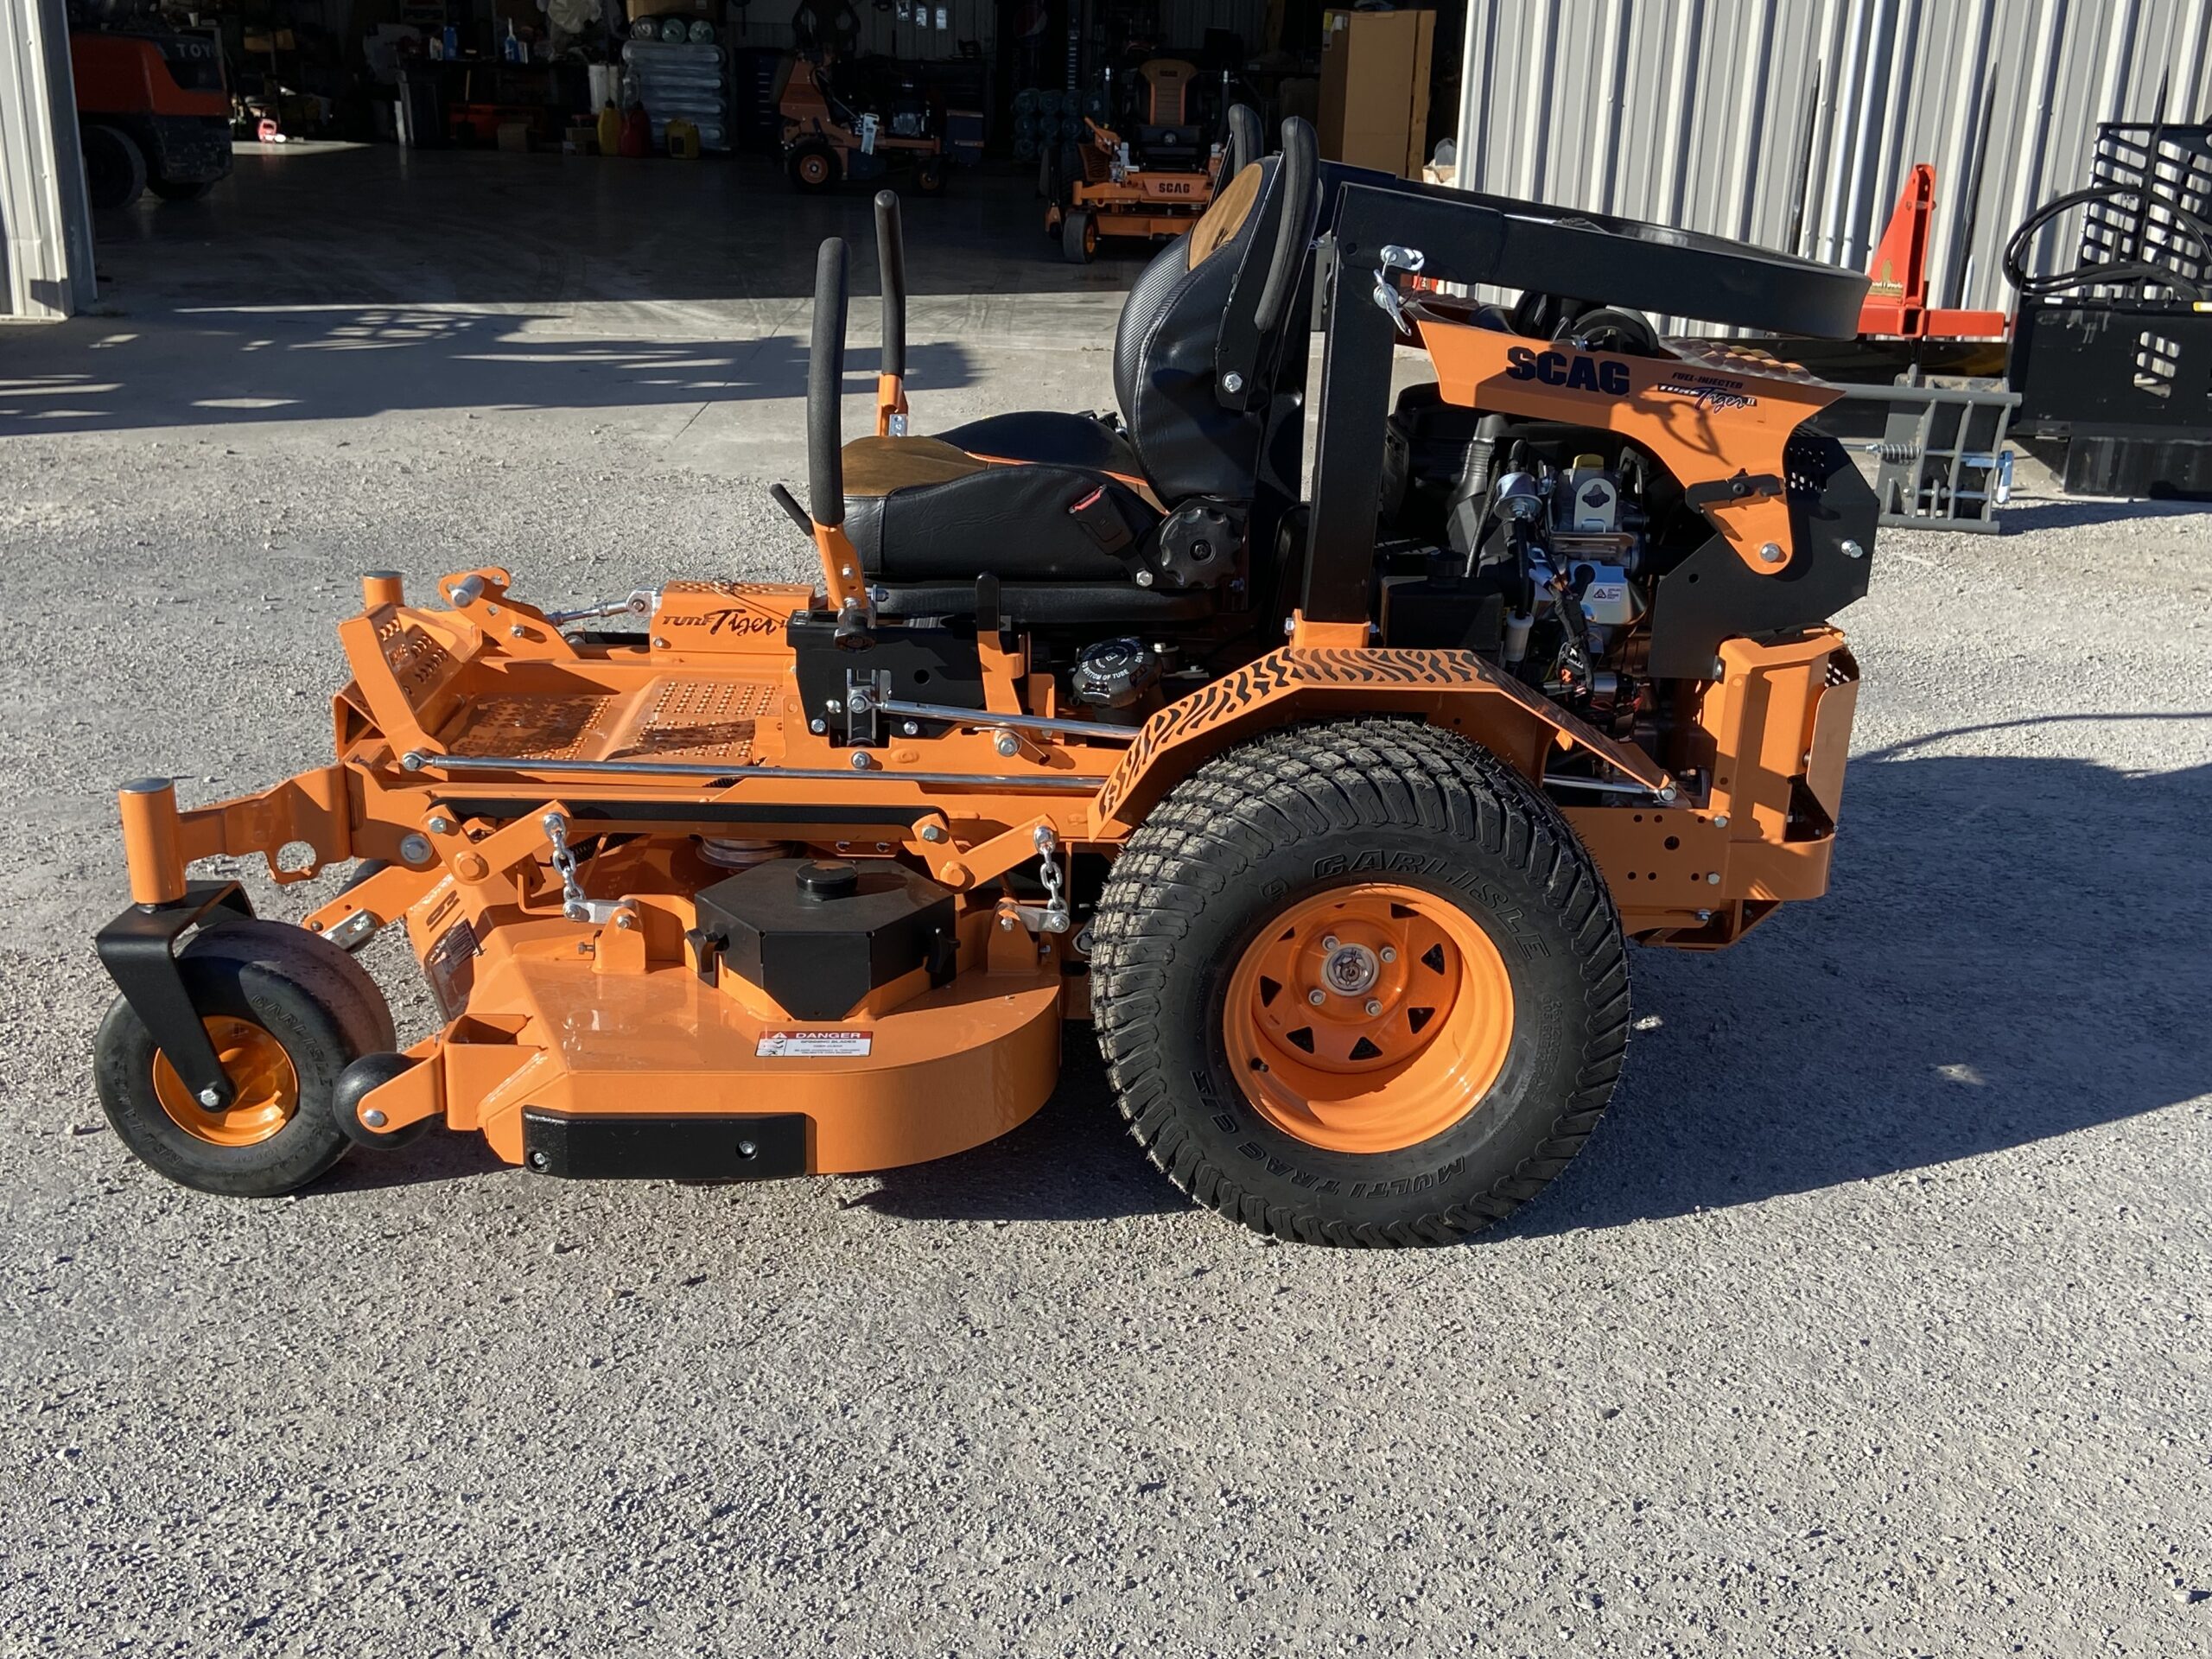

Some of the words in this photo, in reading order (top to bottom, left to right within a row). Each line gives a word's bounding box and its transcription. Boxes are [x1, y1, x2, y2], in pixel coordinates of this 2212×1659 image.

[175, 42, 213, 58] TOY
[1159, 182, 1190, 194] SCAG
[1506, 346, 1630, 397] SCAG
[1691, 386, 1745, 414] Tiger
[704, 608, 777, 637] Tiger
[1112, 669, 1129, 679] TUBE
[1312, 849, 1552, 961] CARLISLE
[251, 994, 334, 1087] CARLISLE
[1236, 1141, 1340, 1196] TRAC
[1349, 1156, 1465, 1198] MULTI
